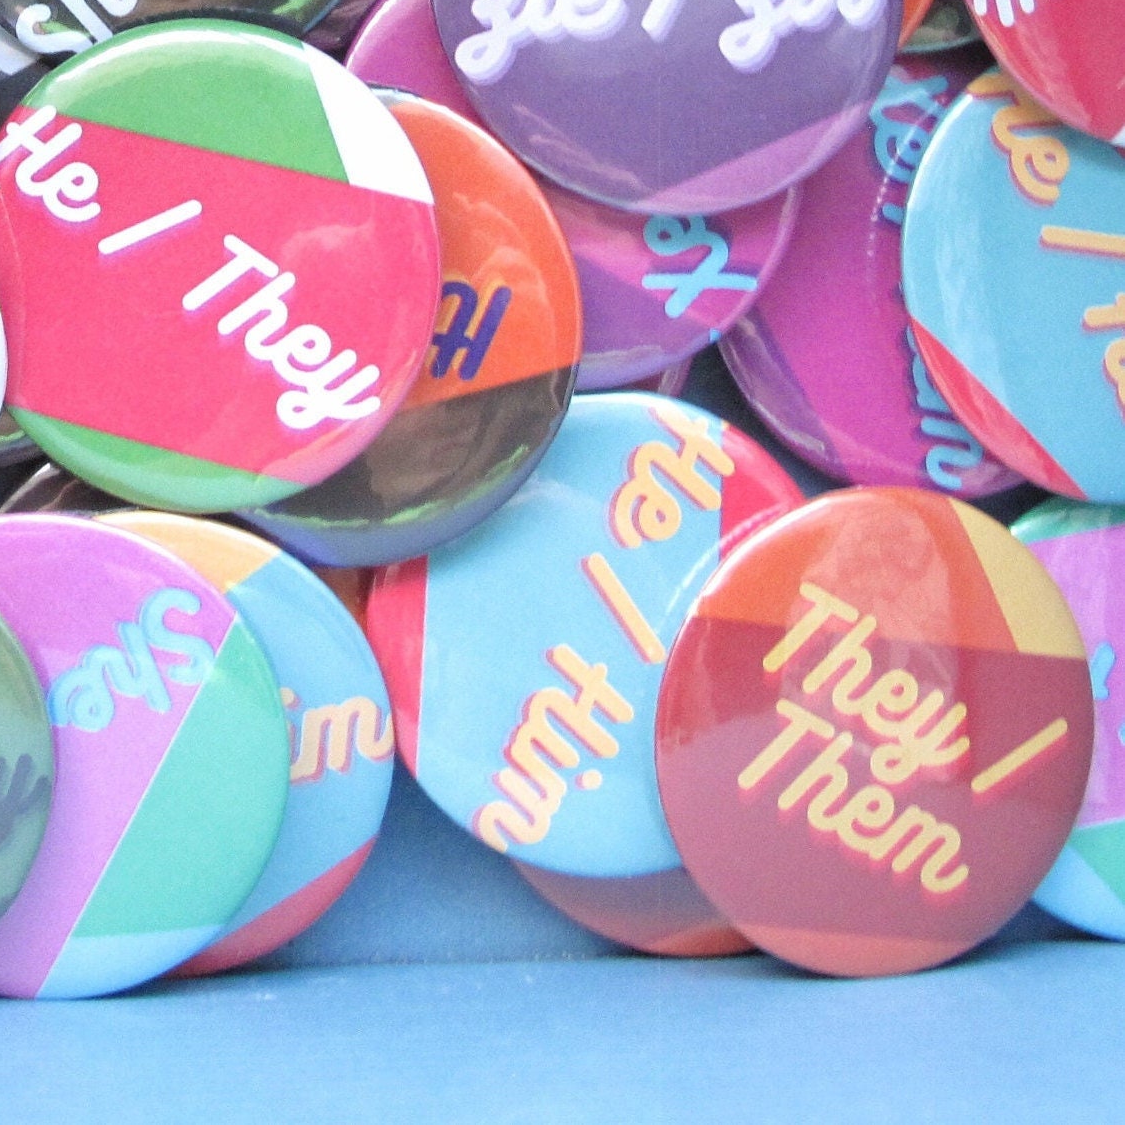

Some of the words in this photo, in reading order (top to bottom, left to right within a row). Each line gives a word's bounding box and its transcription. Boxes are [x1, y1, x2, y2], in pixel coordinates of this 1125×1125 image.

[181, 235, 382, 435] They
[609, 406, 736, 549] He
[47, 587, 215, 733] She
[472, 644, 635, 853] Him
[762, 581, 971, 784] They
[737, 698, 971, 895] Them
